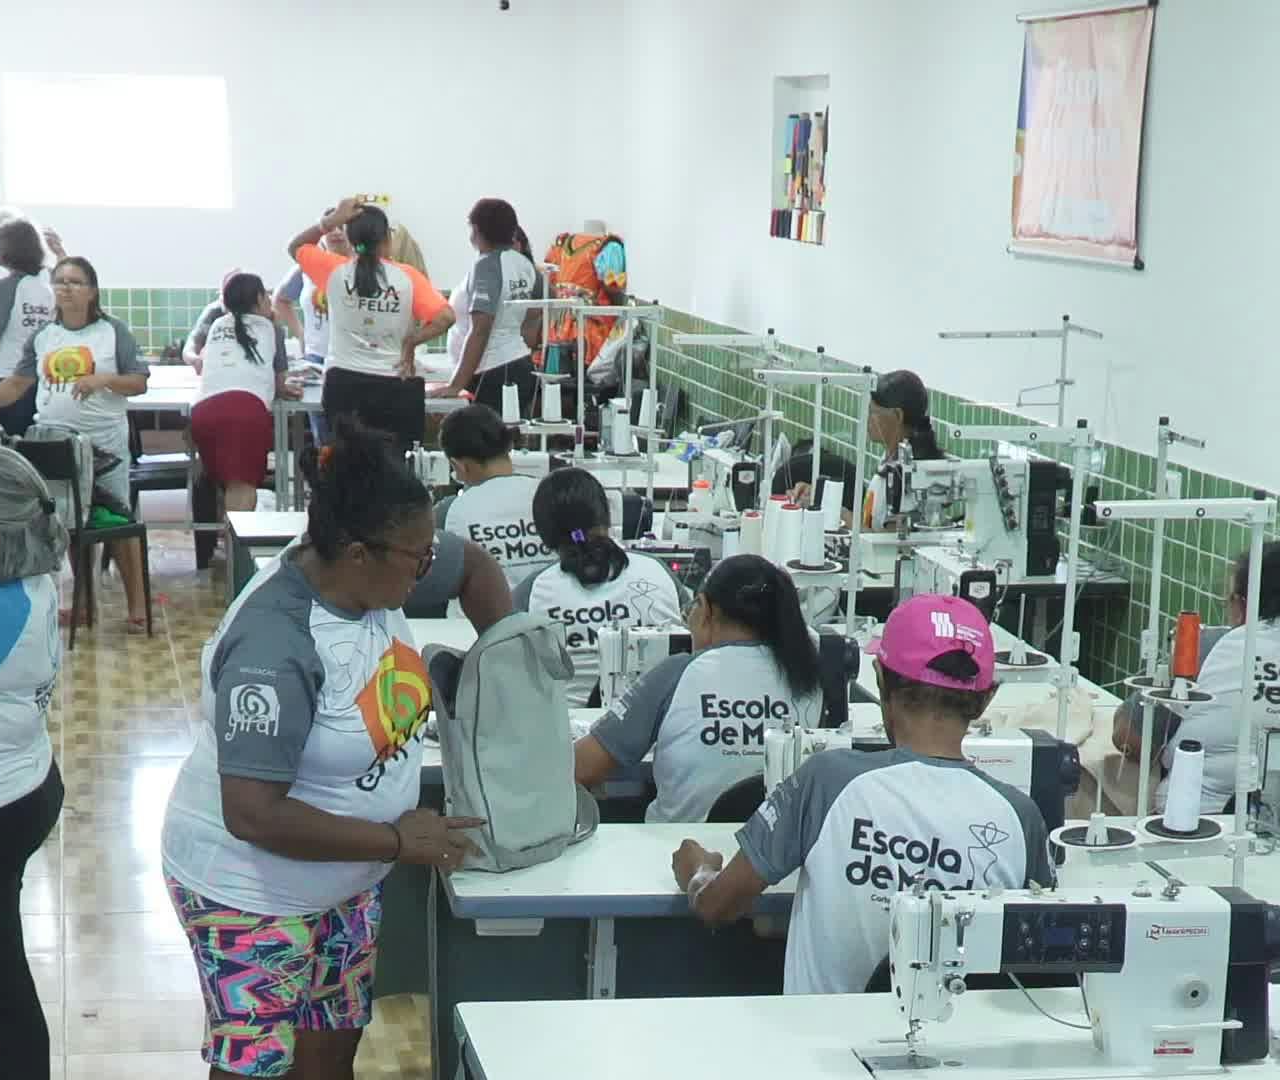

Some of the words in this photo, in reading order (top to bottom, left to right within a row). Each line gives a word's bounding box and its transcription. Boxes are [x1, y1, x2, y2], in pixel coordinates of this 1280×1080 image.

[344, 279, 399, 300] VDA
[358, 299, 400, 313] FELIZ
[547, 599, 630, 626] Escola
[700, 693, 790, 720] Escola
[700, 720, 739, 746] de
[851, 817, 963, 874] Escola
[845, 855, 894, 890] de
